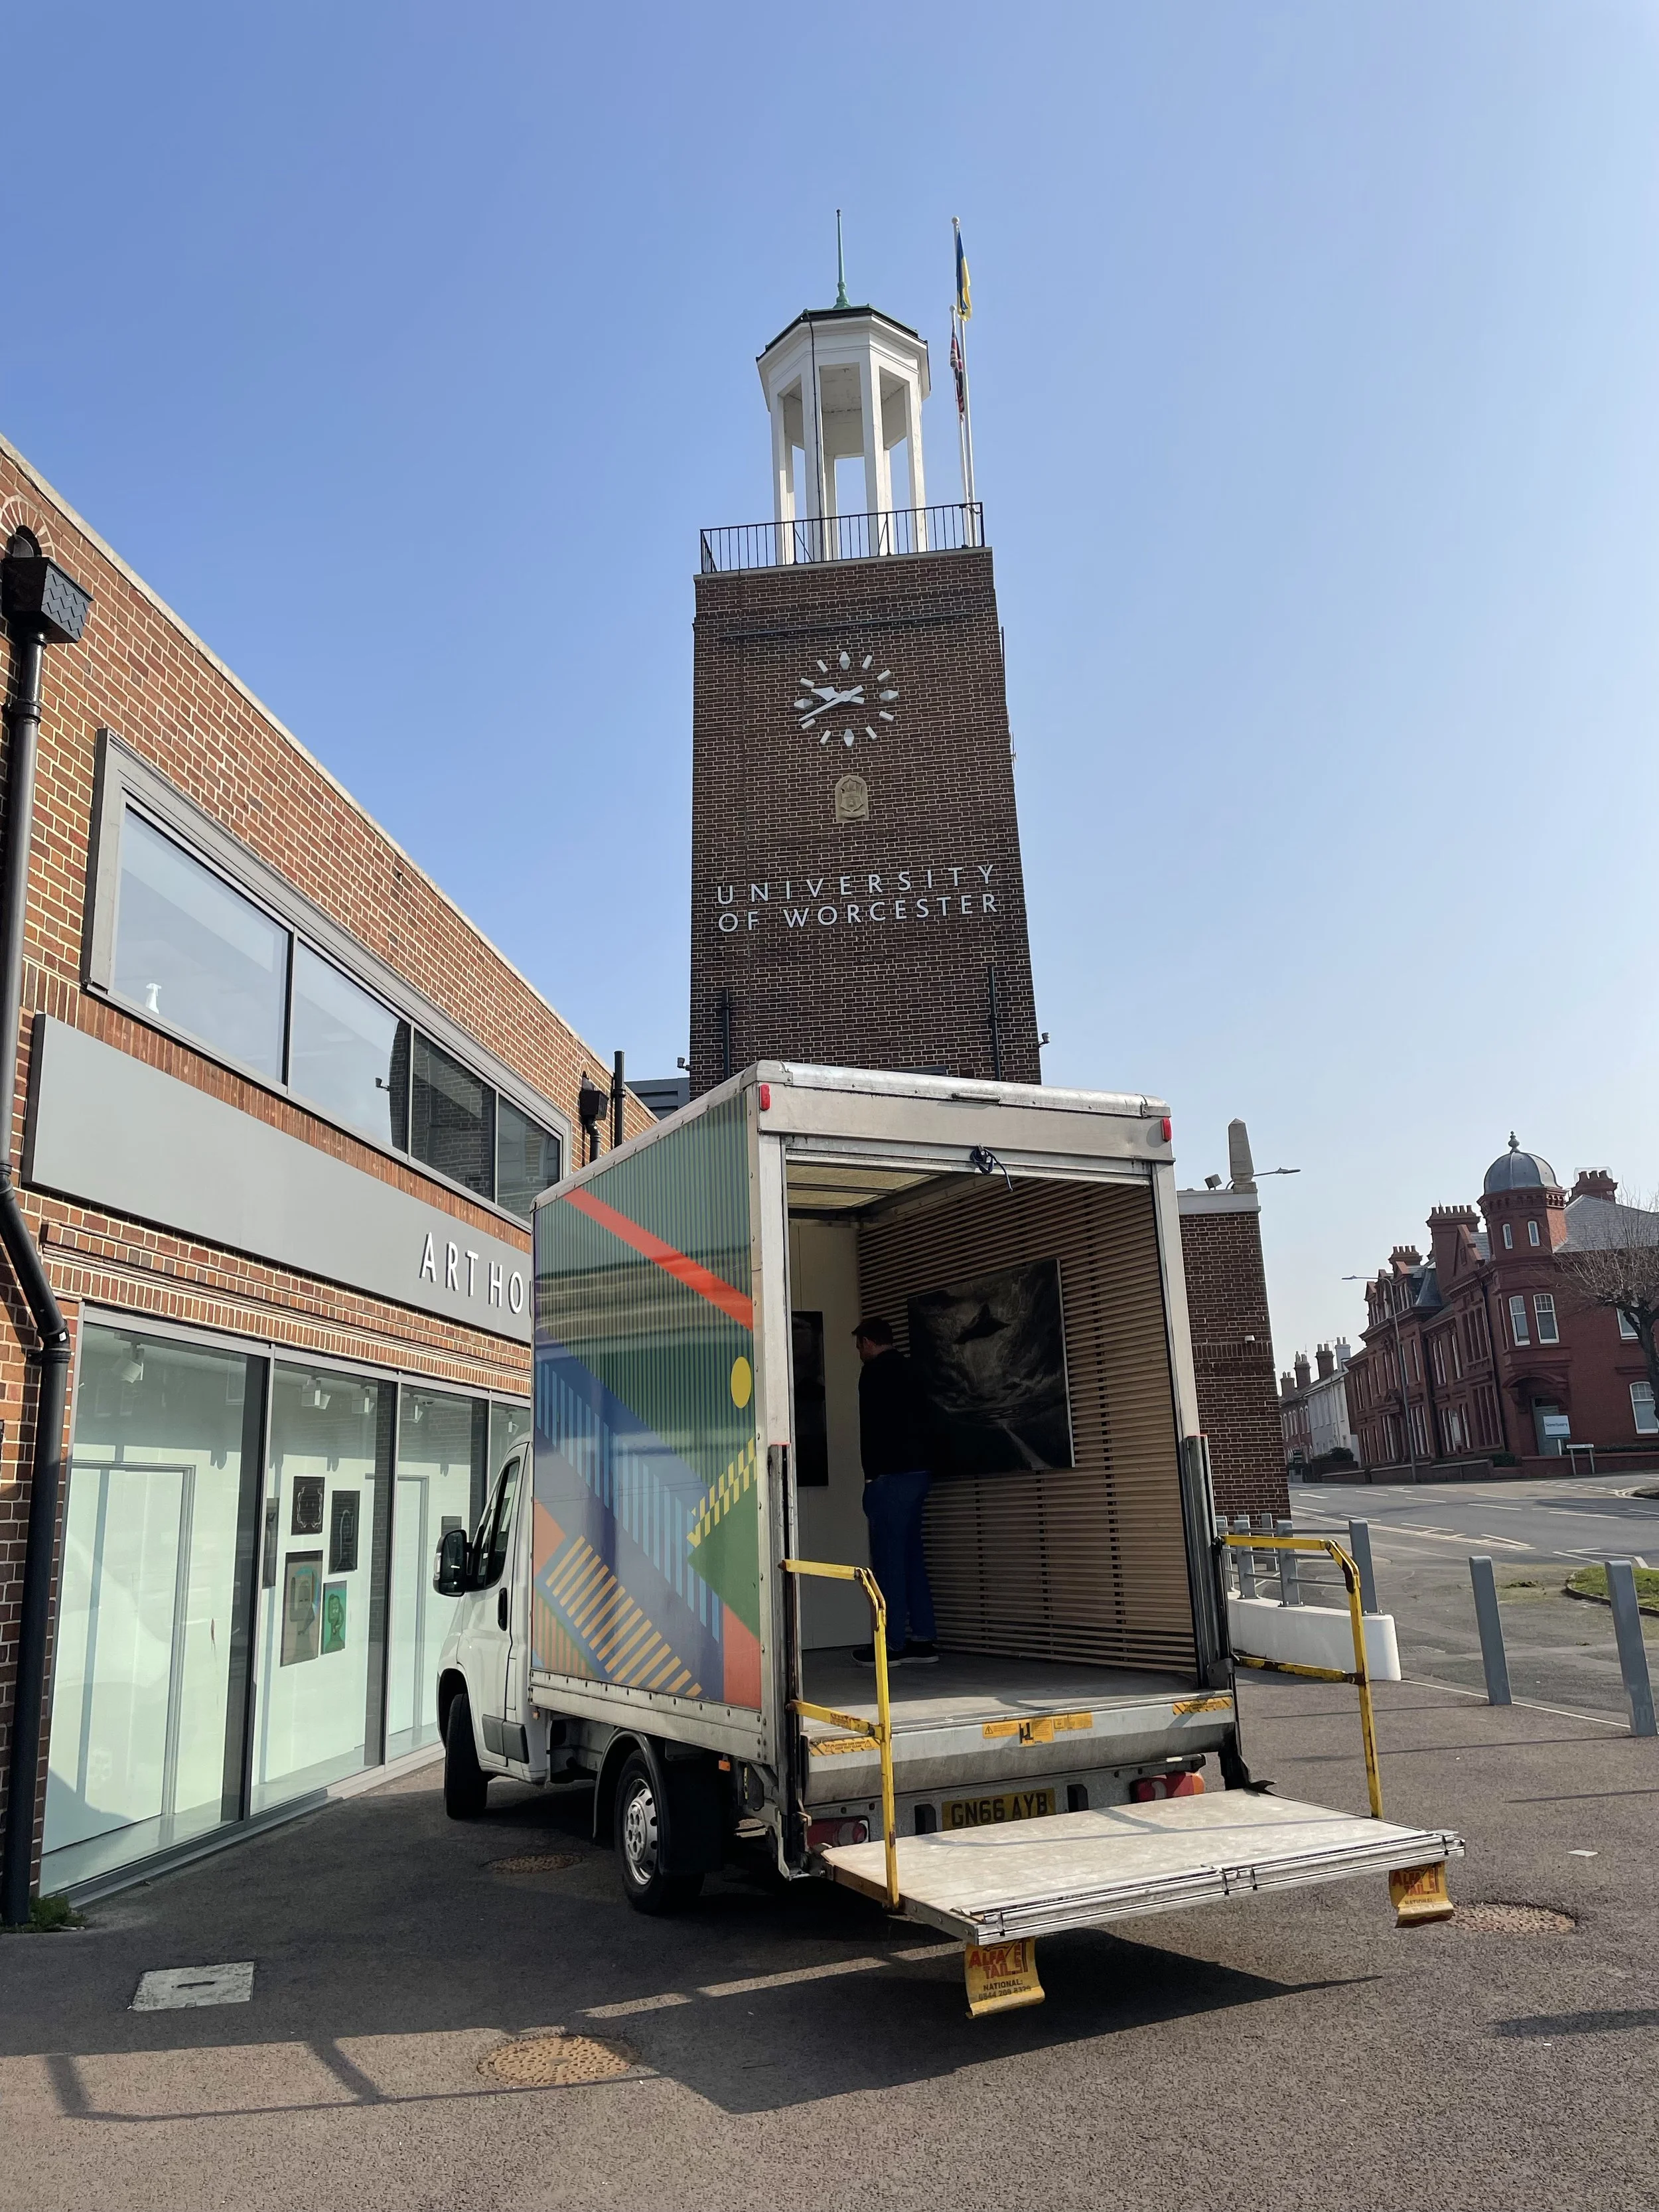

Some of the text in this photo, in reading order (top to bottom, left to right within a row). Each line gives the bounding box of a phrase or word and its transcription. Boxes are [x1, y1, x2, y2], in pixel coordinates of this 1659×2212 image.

[717, 864, 994, 905] UNIVERSITY
[718, 893, 998, 932] OF WORCESTER
[419, 1232, 532, 1319] ART HO
[951, 1793, 1048, 1826] GN66 AYB
[968, 1949, 1007, 1969] ALFA
[983, 1962, 1012, 1979] TAIL
[983, 1978, 1023, 1991] NATIONAL:
